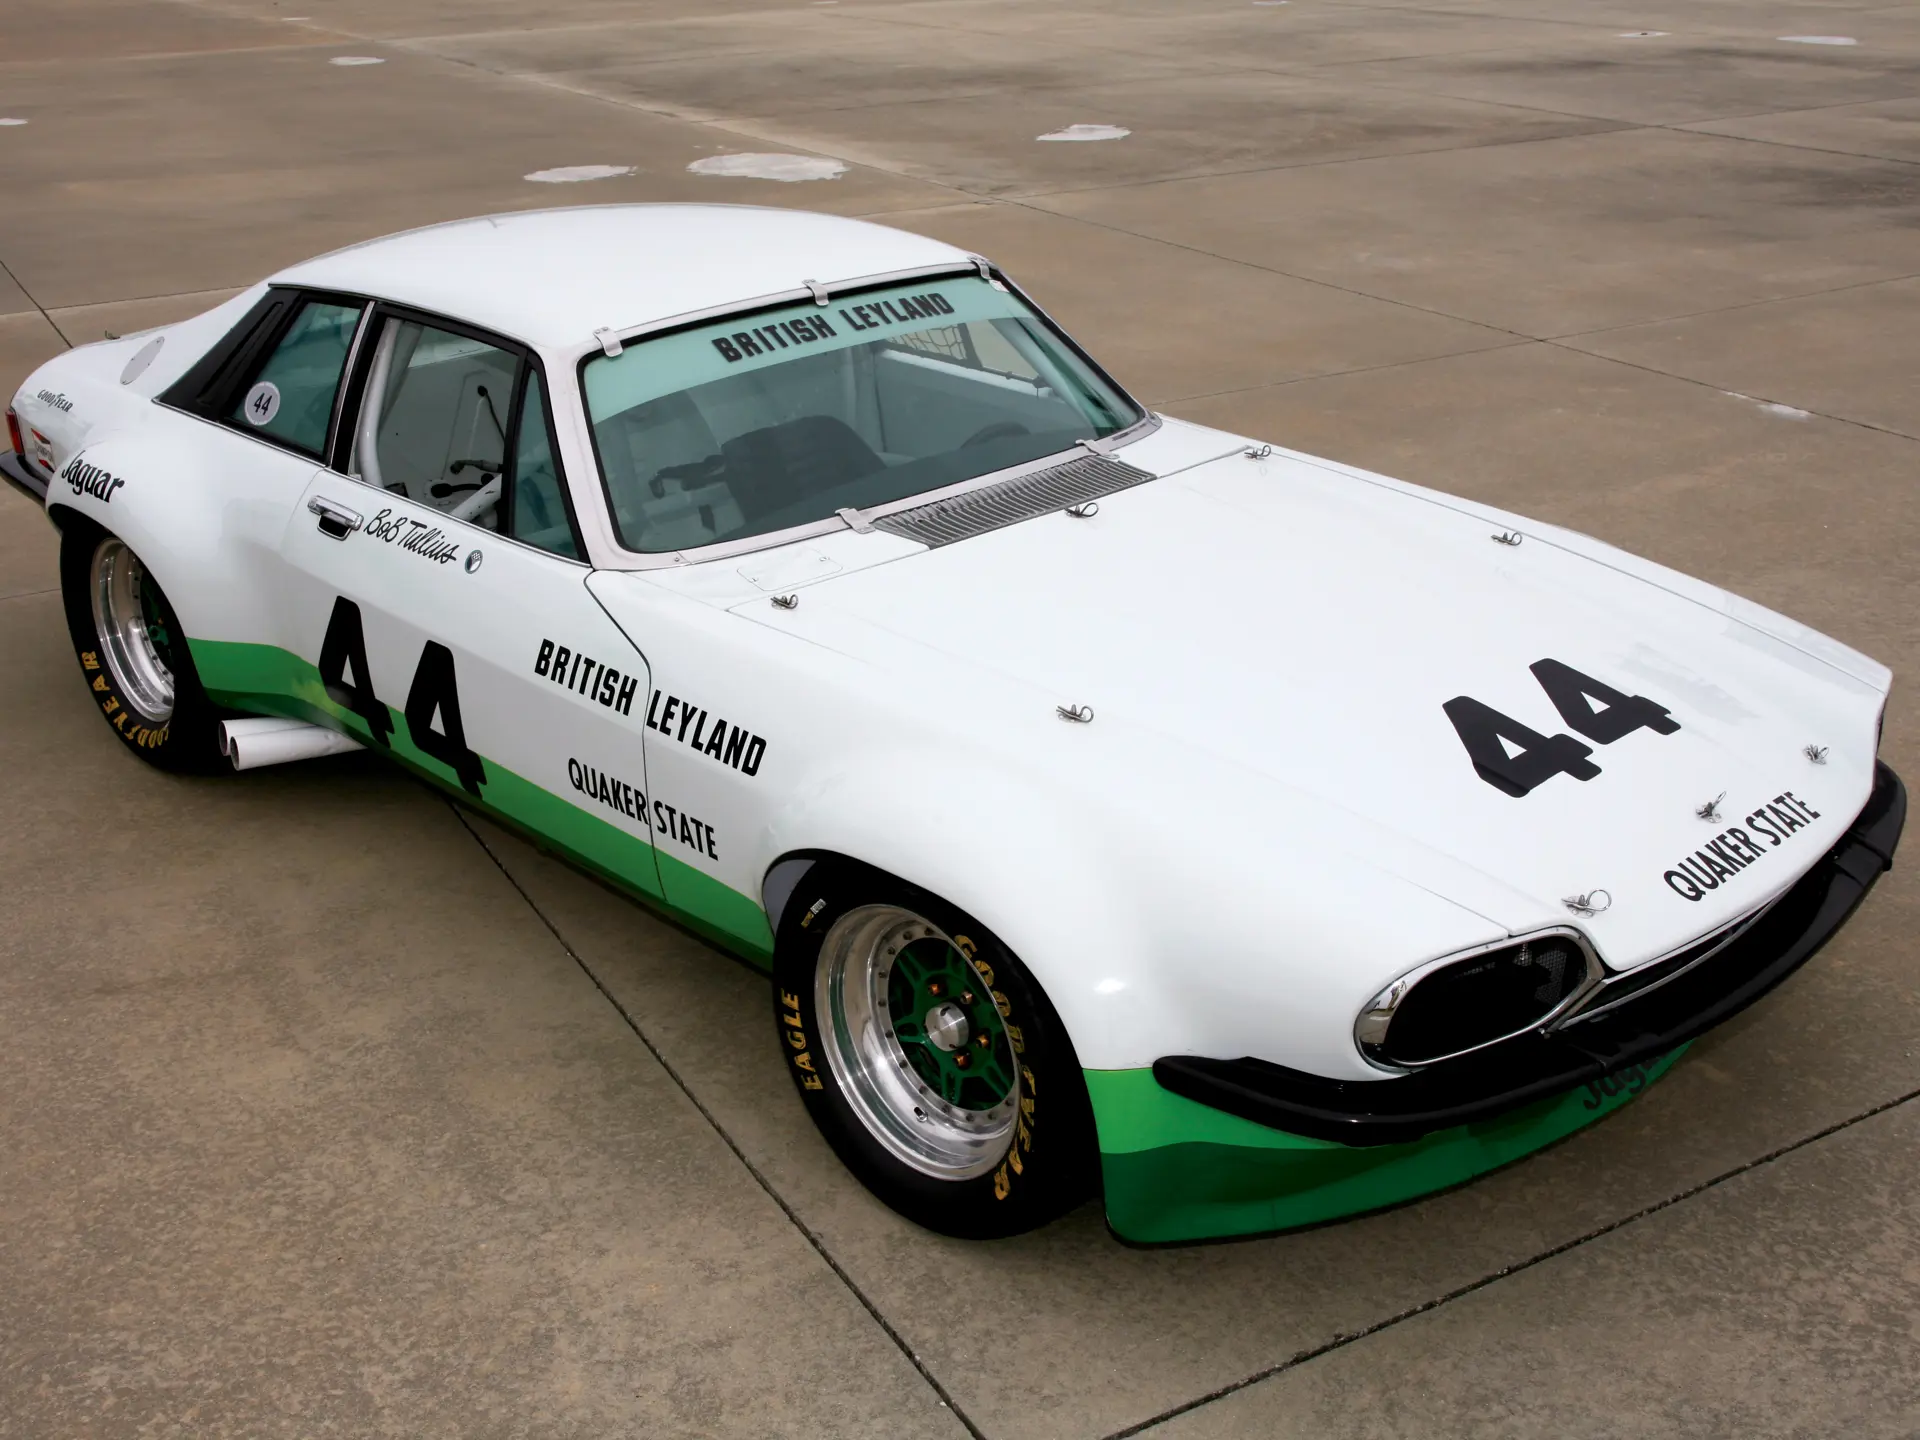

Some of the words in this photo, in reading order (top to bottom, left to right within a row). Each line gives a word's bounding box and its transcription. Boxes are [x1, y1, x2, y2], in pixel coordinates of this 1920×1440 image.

[711, 314, 837, 363] BRITISH
[838, 292, 955, 331] LEYLAND
[254, 392, 272, 416] 44
[61, 450, 125, 502] Jaguar
[318, 595, 488, 801] 44
[534, 638, 638, 717] BRITISH
[646, 688, 767, 777] LEYLAND
[1442, 657, 1682, 798] 44
[568, 757, 650, 826] QUAKER
[653, 800, 719, 862] STATE
[1663, 827, 1767, 902] QUAKER
[1745, 791, 1821, 846] STATE
[781, 988, 823, 1091] EAGLE
